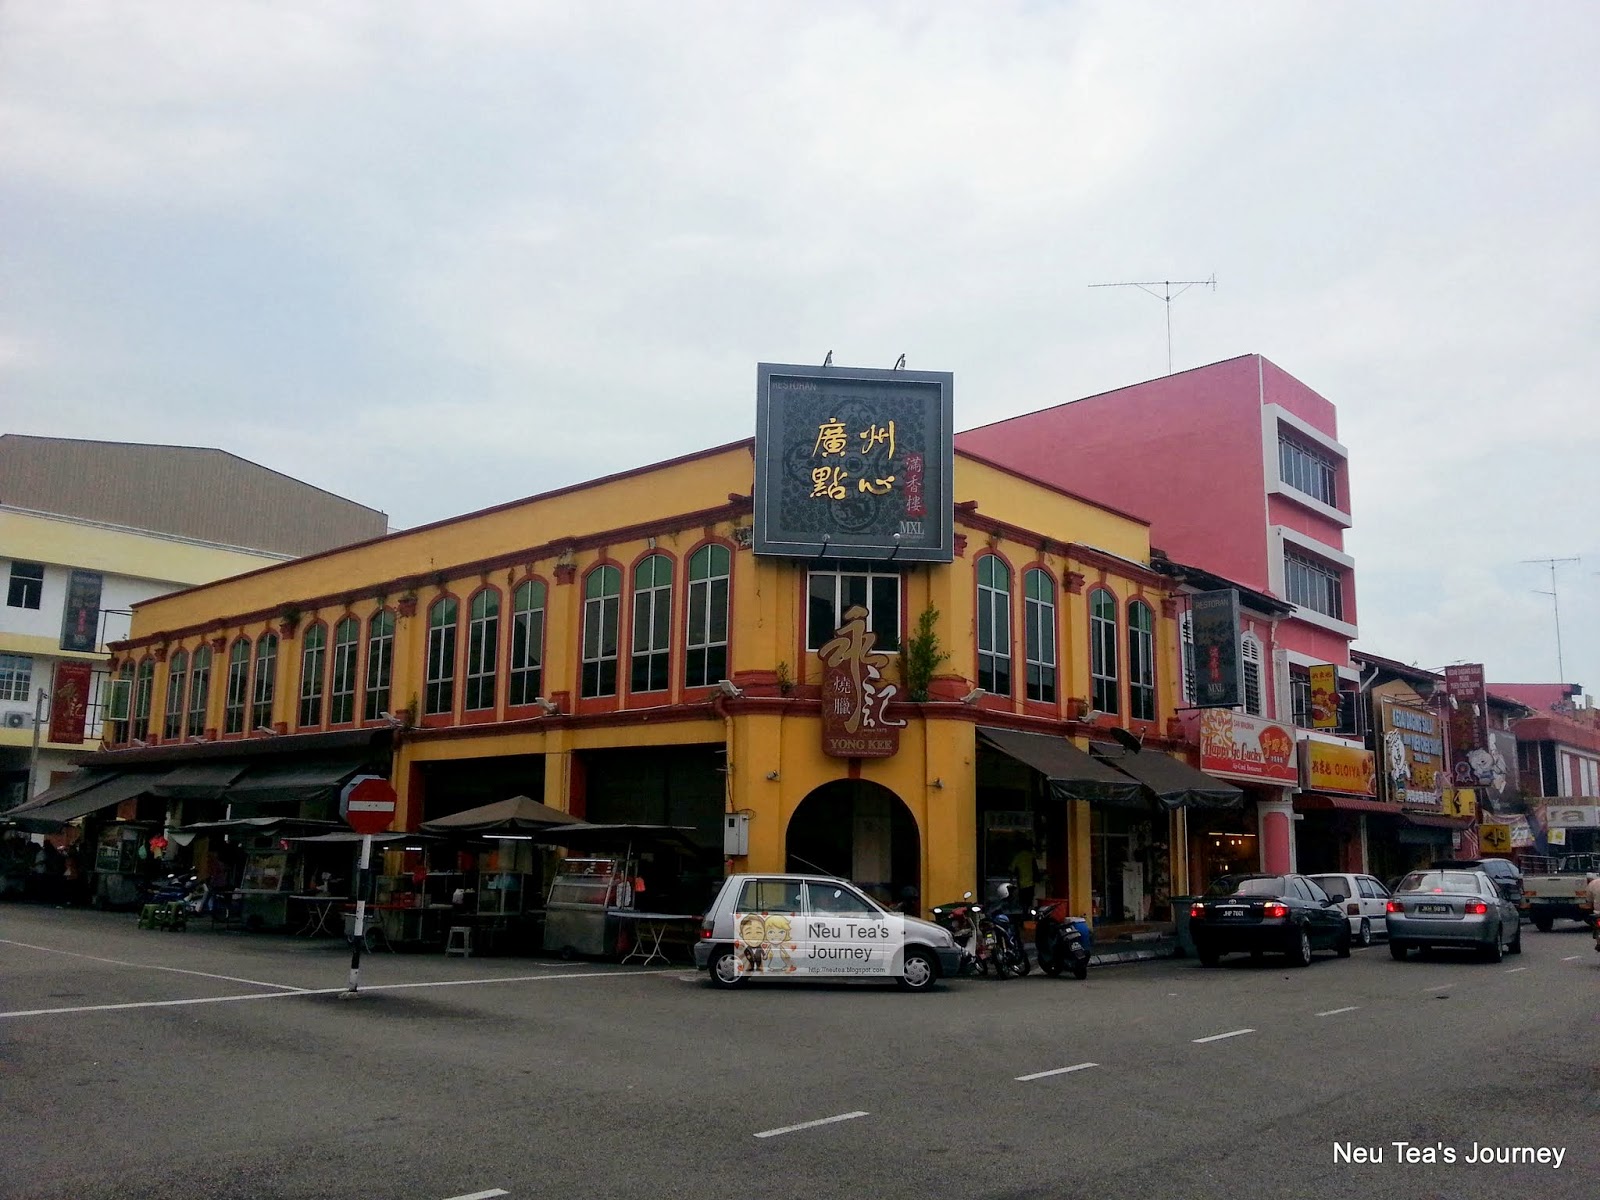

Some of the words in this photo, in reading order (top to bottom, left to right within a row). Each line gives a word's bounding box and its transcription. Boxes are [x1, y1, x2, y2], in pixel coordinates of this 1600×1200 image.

[812, 417, 895, 460] 廣州
[810, 466, 896, 500] 點心
[900, 521, 925, 534] MXL
[1194, 599, 1229, 609] RESTORAN
[831, 739, 865, 750] YONG
[868, 739, 892, 750] KEE
[1204, 737, 1230, 758] Happy
[1231, 741, 1241, 760] Go
[1241, 742, 1263, 762] Lucky
